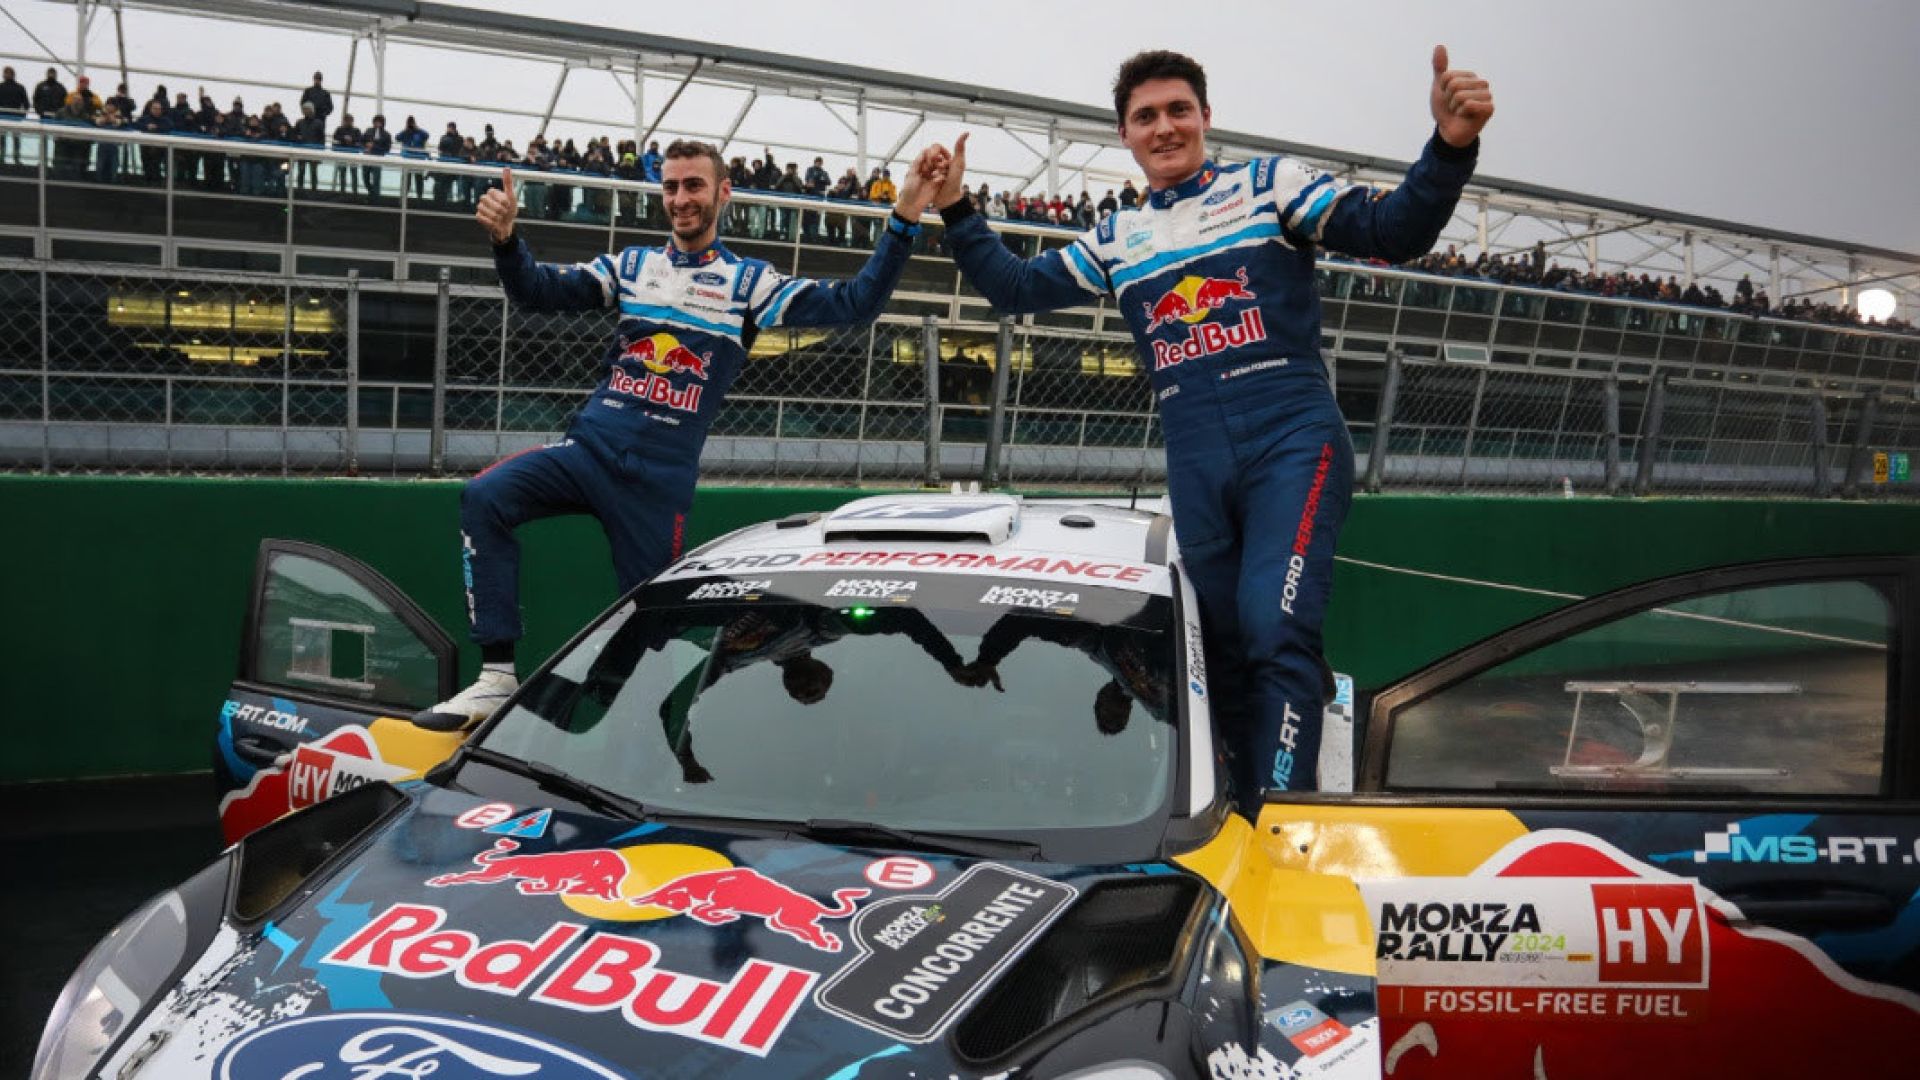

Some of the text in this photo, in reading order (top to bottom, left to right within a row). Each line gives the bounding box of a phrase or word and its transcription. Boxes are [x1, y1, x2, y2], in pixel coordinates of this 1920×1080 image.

[1152, 306, 1267, 373] Red Bull
[609, 365, 703, 412] Red Bull
[672, 551, 1154, 582] FORD PERFORMANCE
[834, 579, 918, 591] MONZA
[979, 593, 1056, 608] RALLY
[987, 585, 1080, 603] MONZA
[1280, 554, 1305, 615] FORD
[222, 700, 308, 733] S-RT.COM
[293, 763, 330, 804] HY
[1380, 902, 1541, 932] MONZA
[873, 881, 1046, 1021] CONCORRENTE
[1376, 933, 1508, 962] RALLY
[1511, 933, 1567, 951] 2024
[1601, 907, 1694, 964] HY
[319, 903, 583, 997] Red
[529, 931, 820, 1058] Bull
[1423, 990, 1688, 1018] FOSSIL-FREE FUEL
